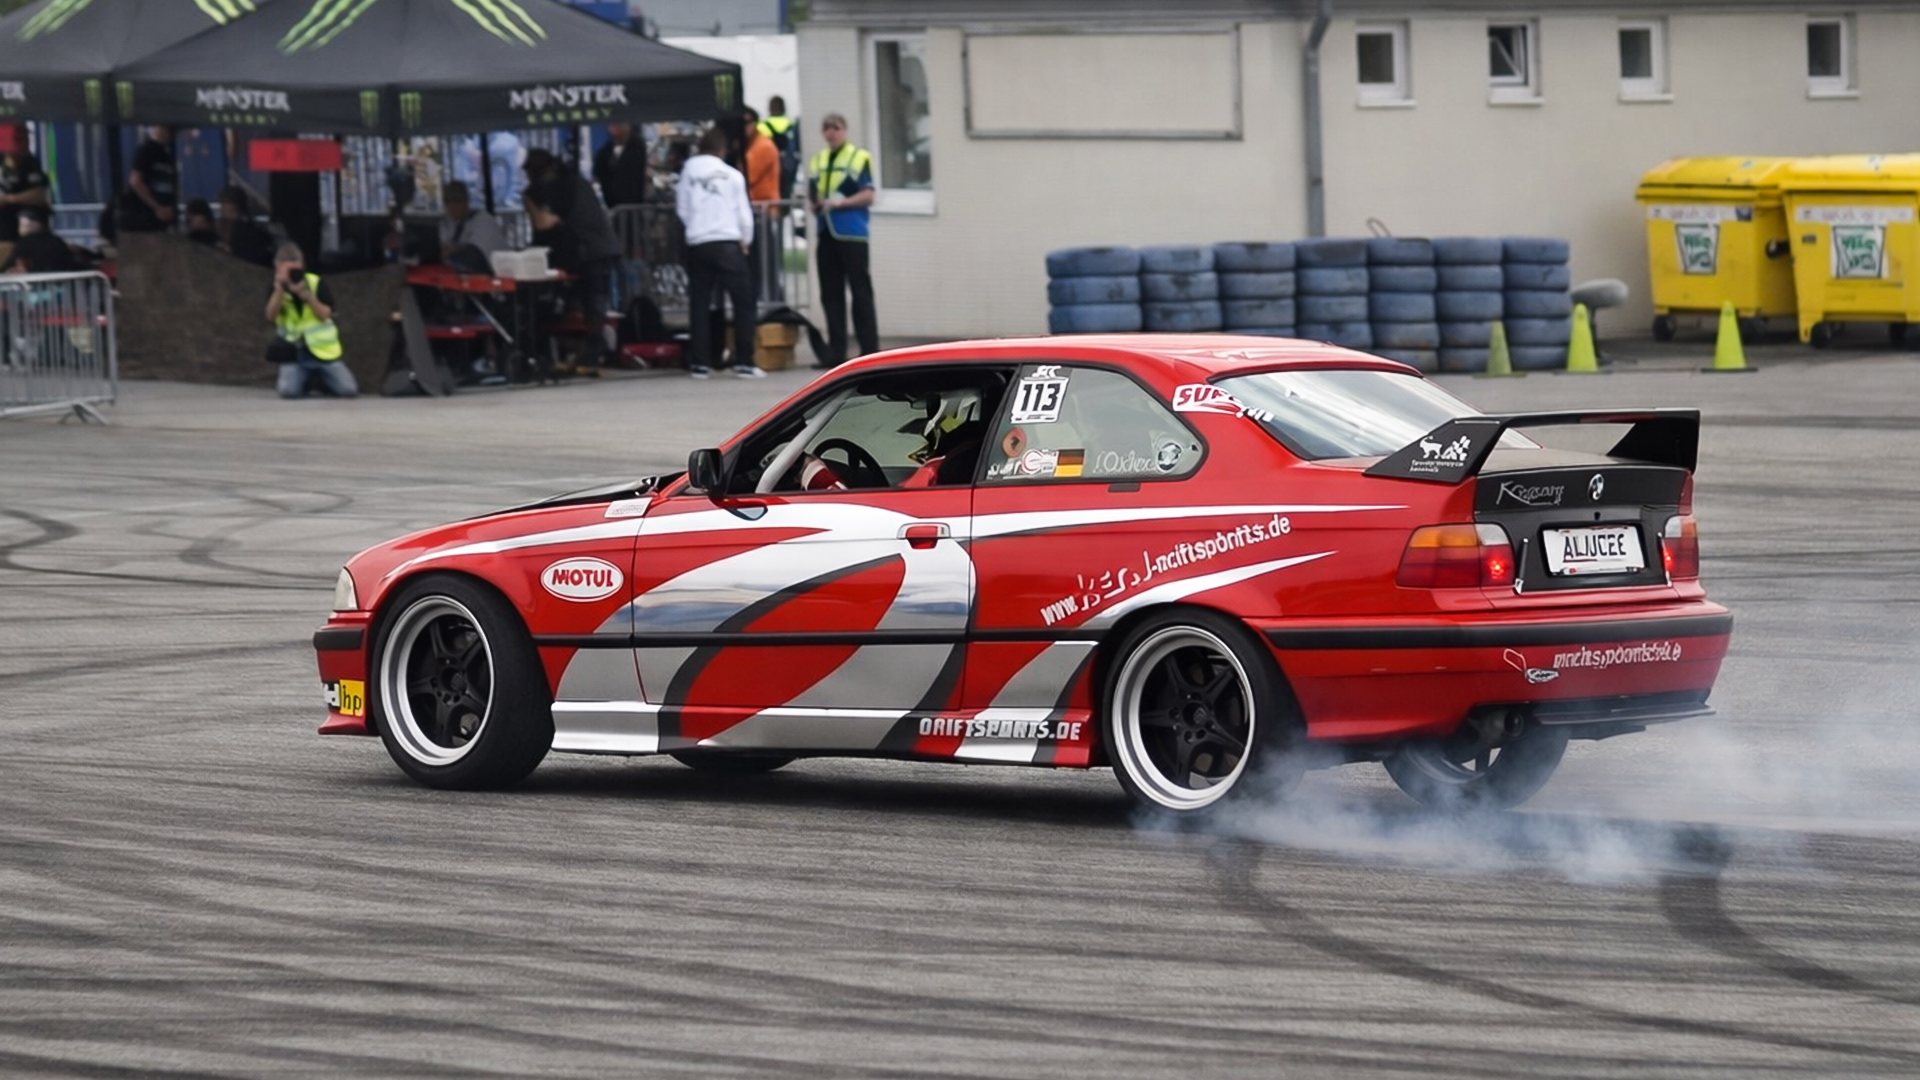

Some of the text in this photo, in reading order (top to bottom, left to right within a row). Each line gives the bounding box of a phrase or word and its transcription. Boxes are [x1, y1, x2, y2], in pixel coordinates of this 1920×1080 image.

[509, 84, 628, 110] MONSTER
[1020, 383, 1061, 411] 113
[551, 569, 613, 587] MOTUL
